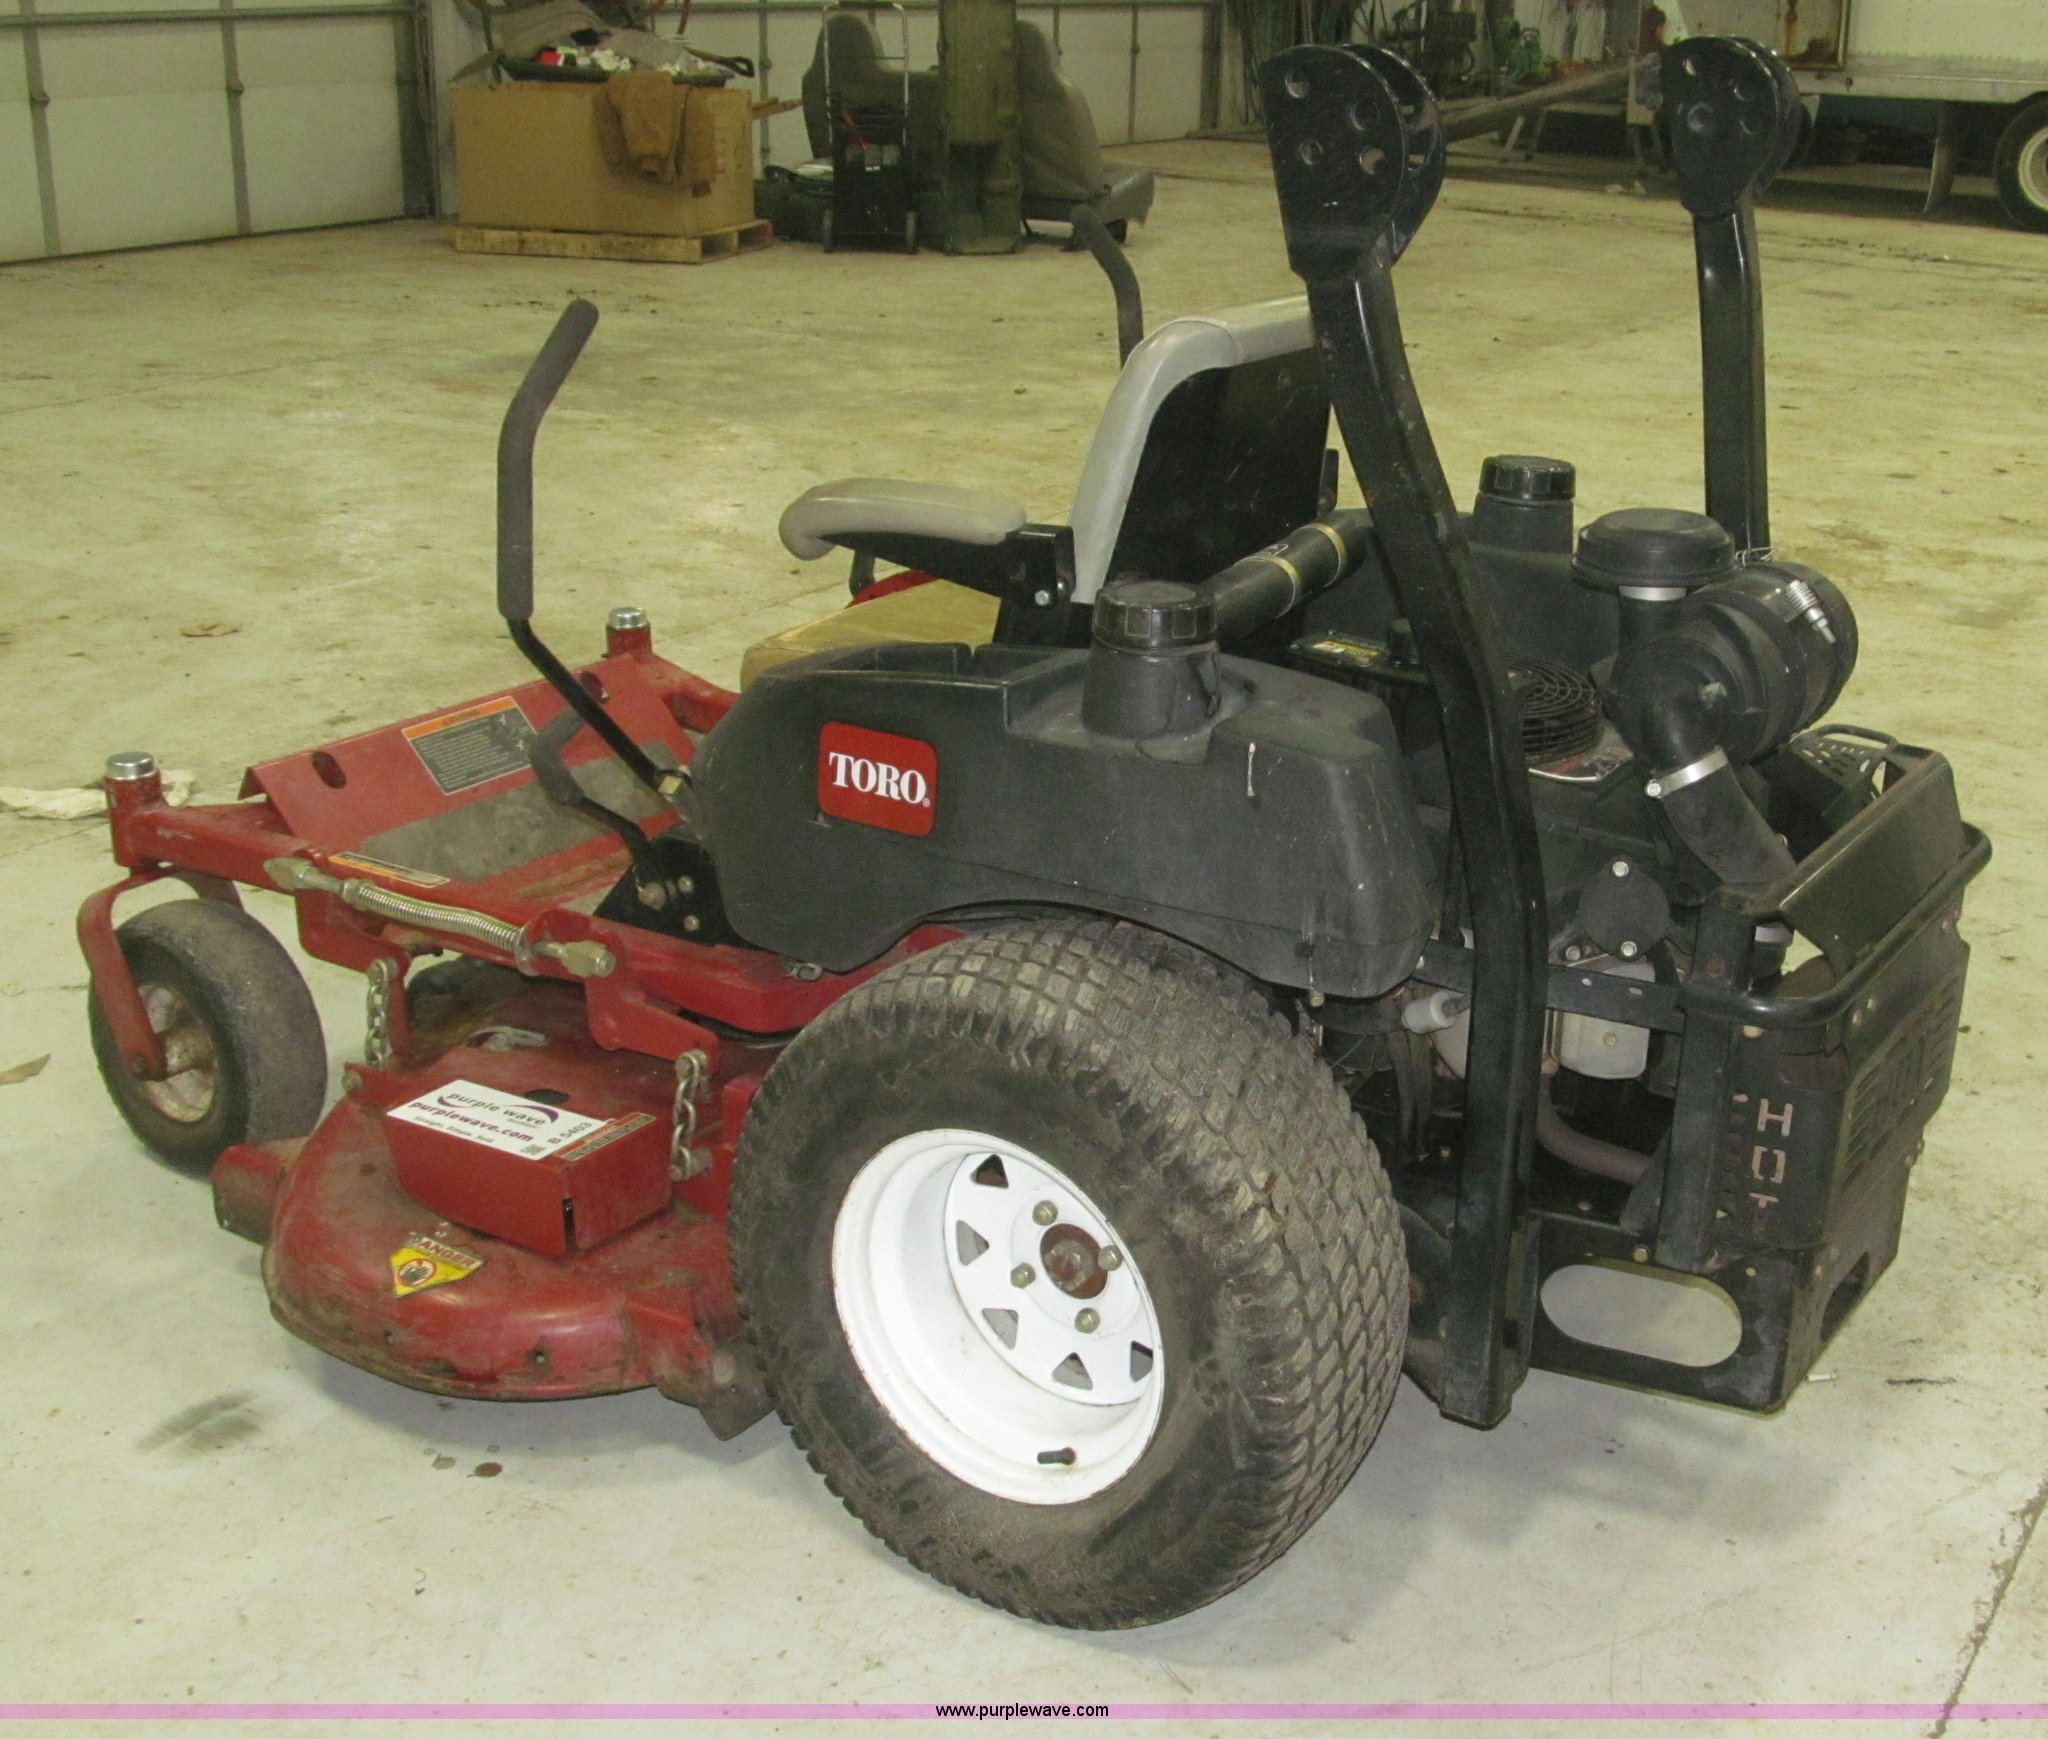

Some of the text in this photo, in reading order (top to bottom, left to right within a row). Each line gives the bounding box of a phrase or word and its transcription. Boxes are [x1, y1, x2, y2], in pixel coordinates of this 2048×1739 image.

[829, 752, 927, 804] TORO
[408, 1101, 534, 1142] purplewave.com
[447, 1092, 546, 1126] purple wave
